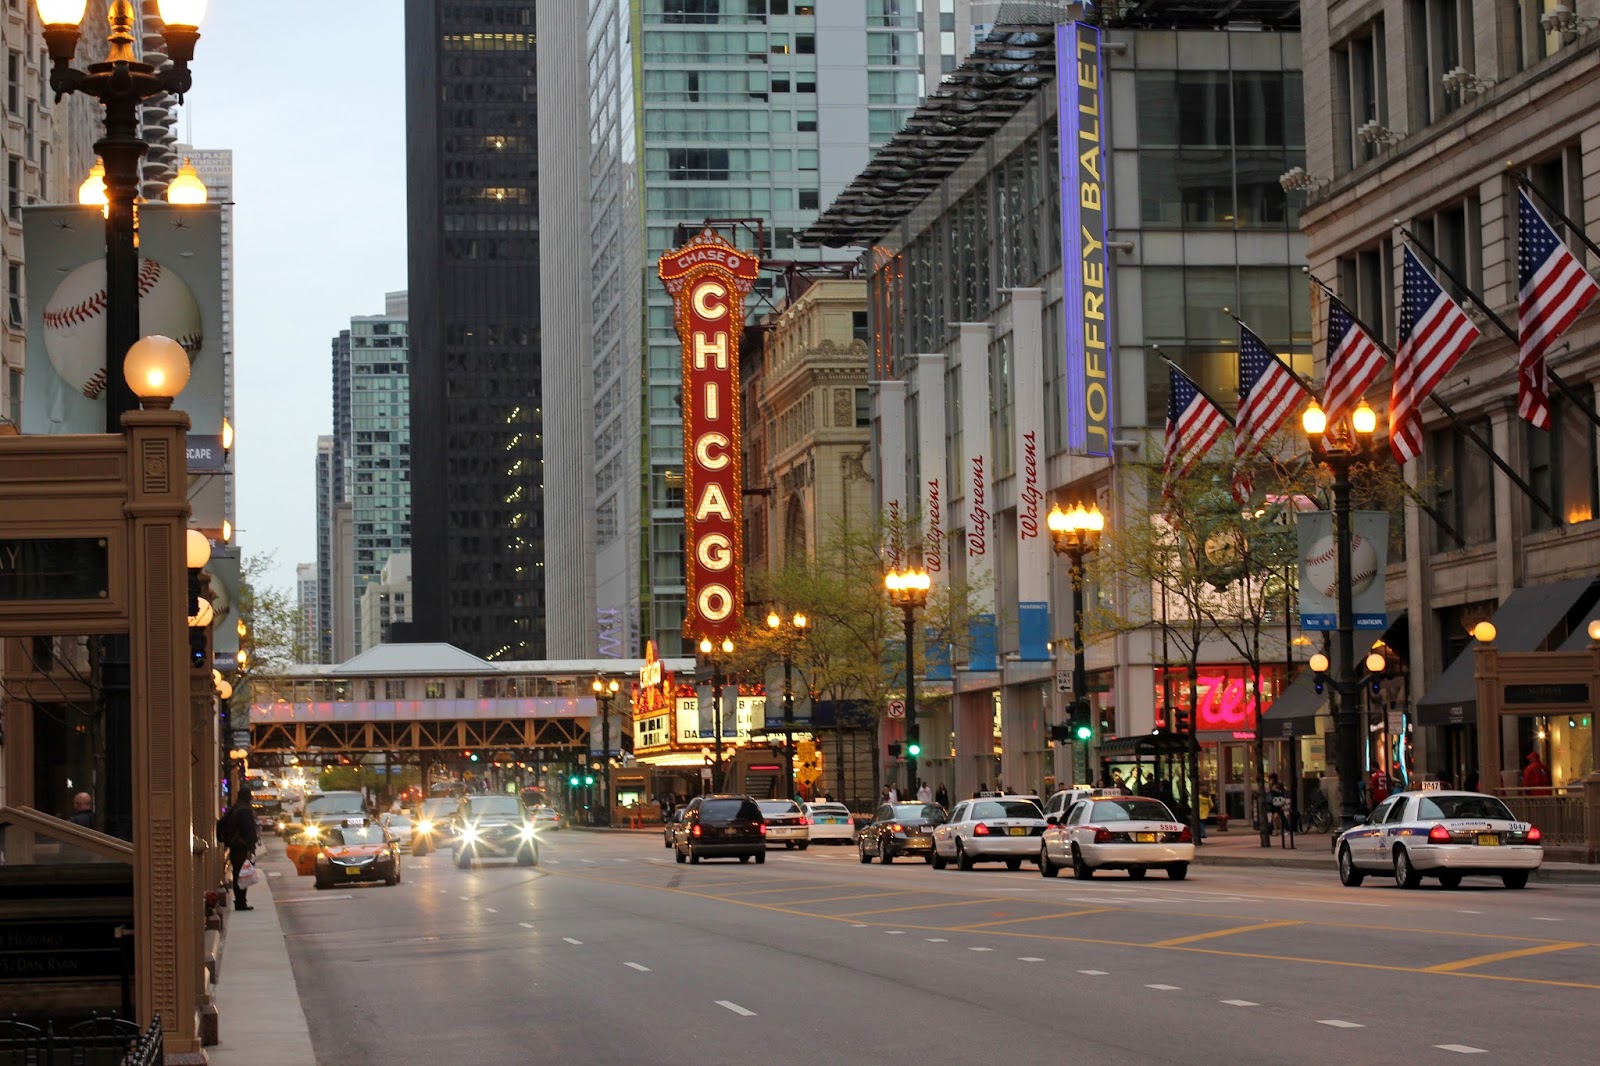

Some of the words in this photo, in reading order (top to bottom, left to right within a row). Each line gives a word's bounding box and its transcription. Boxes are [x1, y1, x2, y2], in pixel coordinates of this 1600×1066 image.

[1077, 29, 1101, 212] BALLET
[677, 250, 726, 269] CHASE
[1081, 224, 1109, 447] JOFFREY
[692, 281, 734, 623] CHICAGO
[1016, 430, 1043, 541] Walgreens
[925, 477, 946, 574] Walgreens
[965, 454, 991, 558] Walgreens
[1159, 823, 1179, 831] 5595
[1423, 782, 1439, 790] 3047
[1508, 822, 1527, 831] 3047
